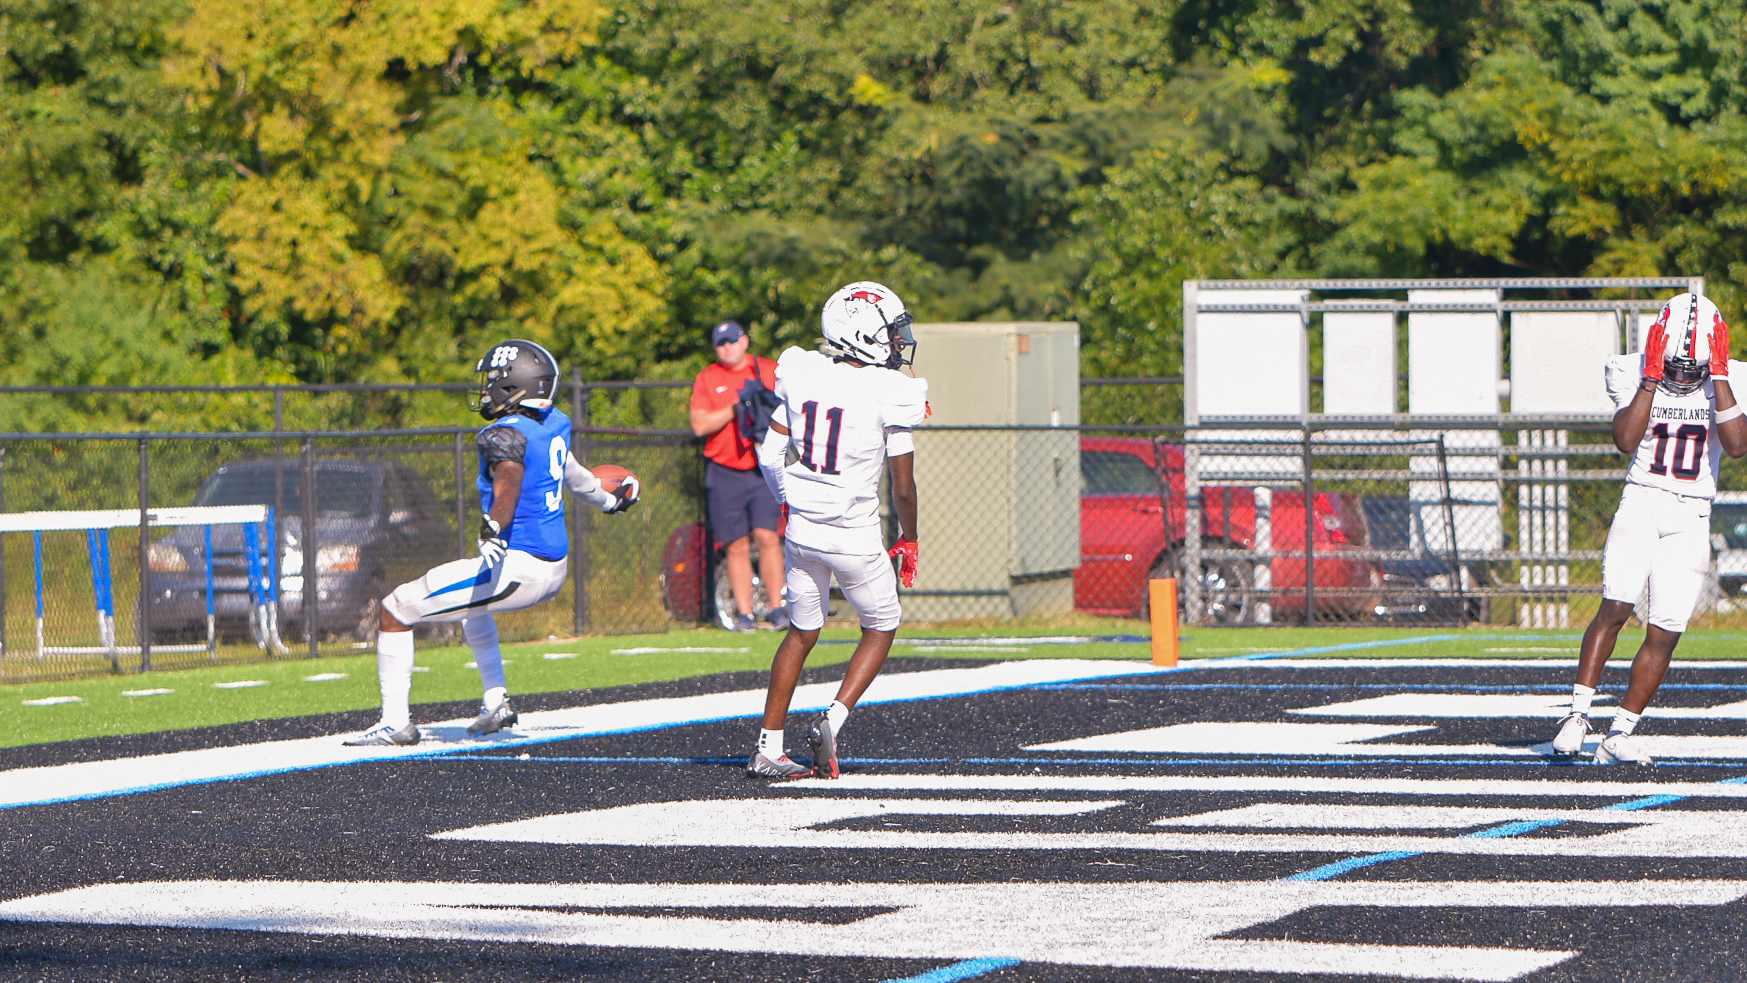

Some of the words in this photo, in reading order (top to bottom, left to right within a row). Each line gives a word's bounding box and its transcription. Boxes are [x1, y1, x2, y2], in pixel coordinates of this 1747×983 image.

[800, 400, 844, 475] 11
[1651, 406, 1710, 420] CUMBERLANDS
[545, 435, 568, 512] 9
[1648, 423, 1709, 481] 10
